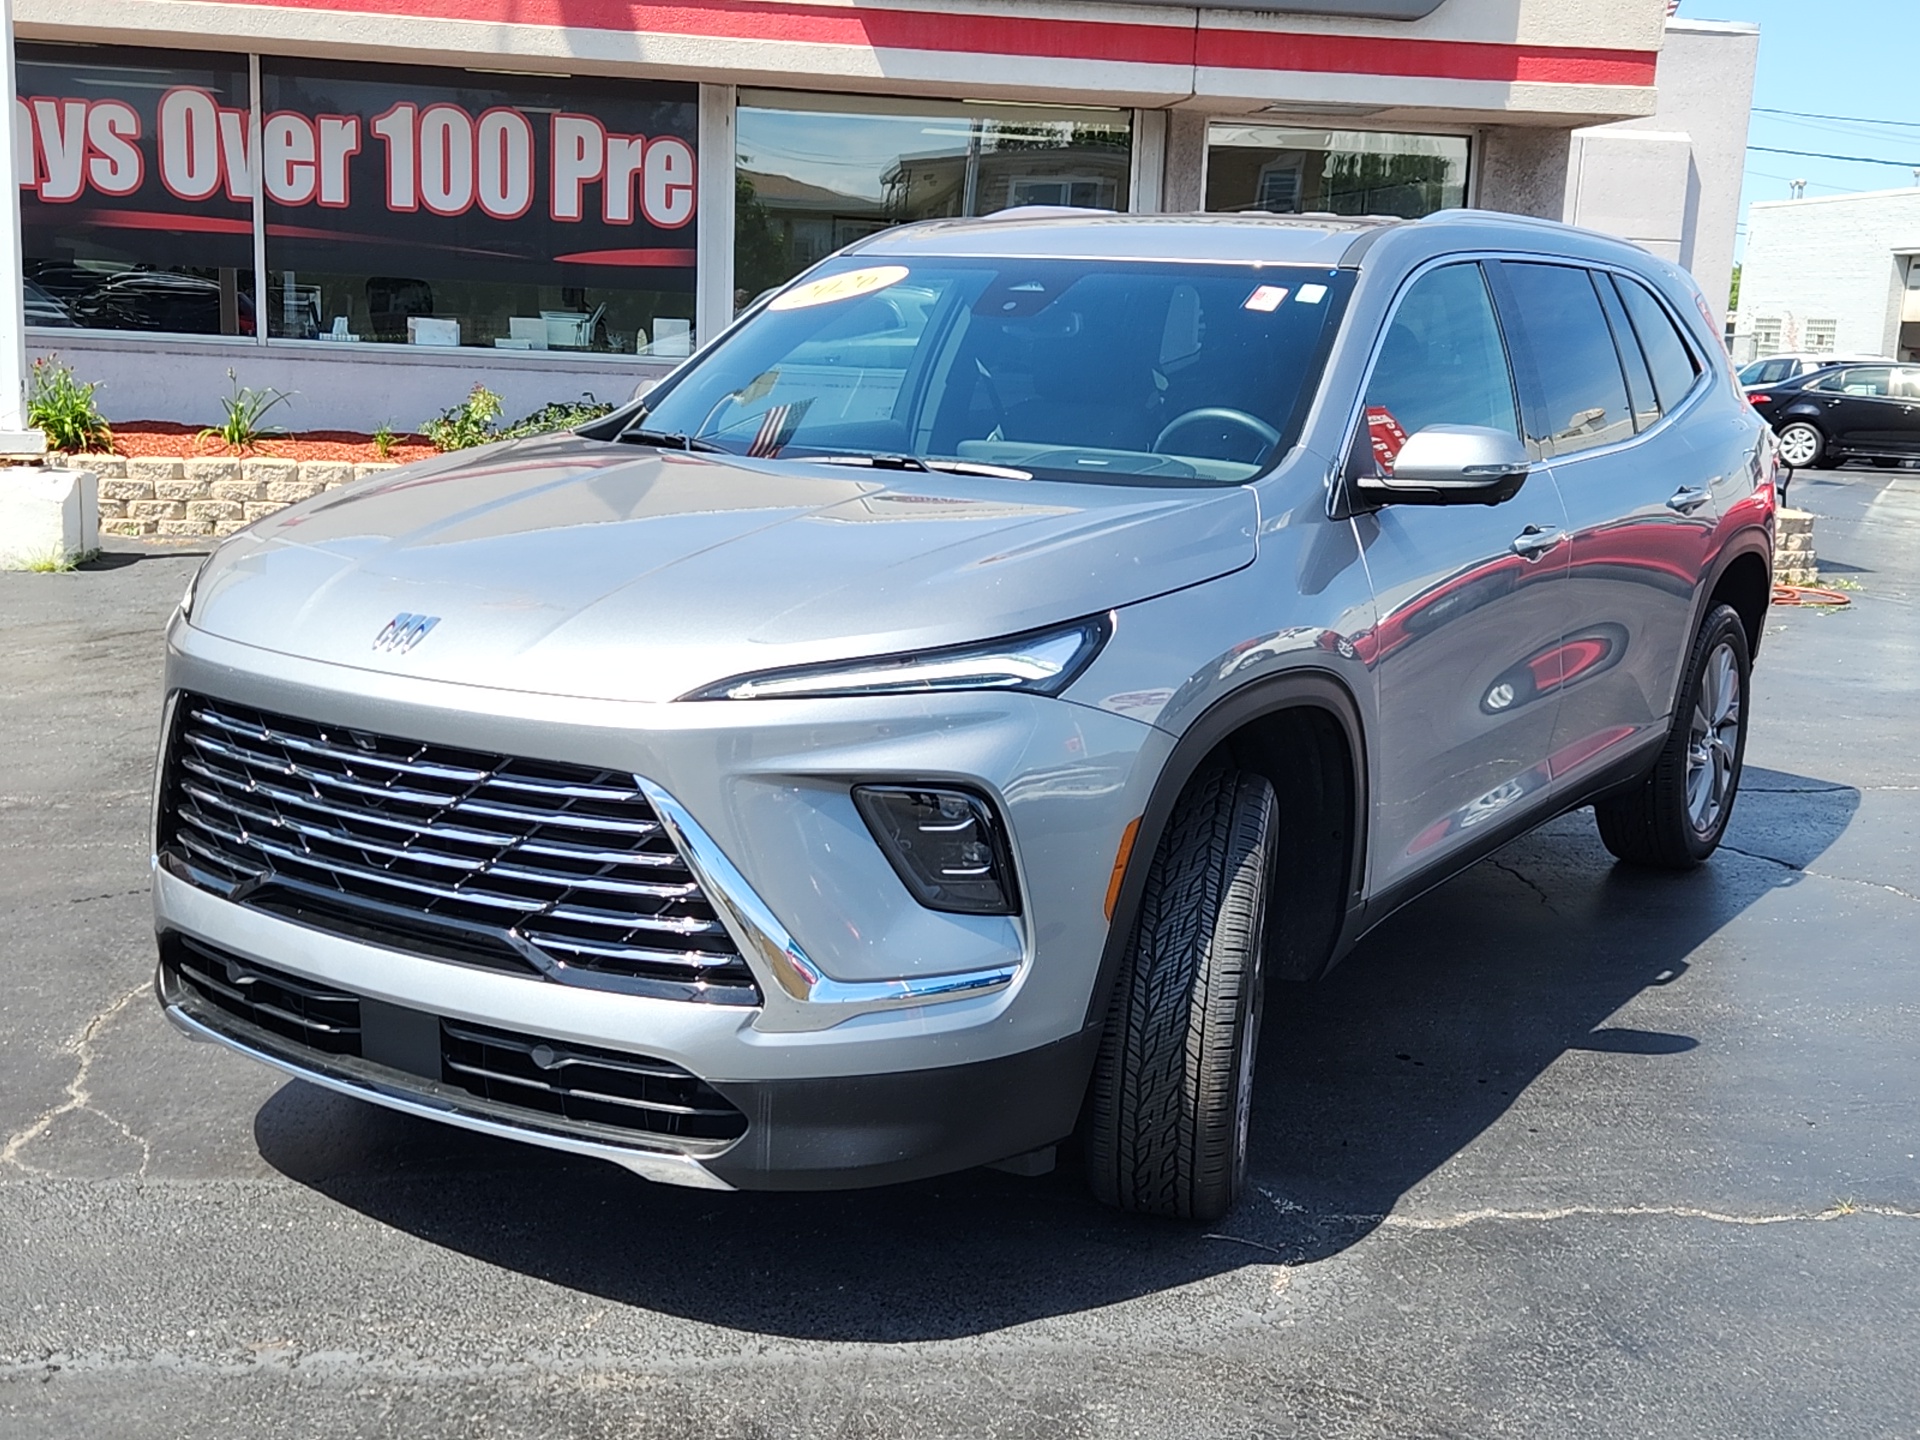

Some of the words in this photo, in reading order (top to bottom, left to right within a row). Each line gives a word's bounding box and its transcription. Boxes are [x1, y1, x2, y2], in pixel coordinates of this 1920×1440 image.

[158, 86, 360, 206] Over
[372, 102, 533, 219] 100
[550, 113, 696, 228] Pre
